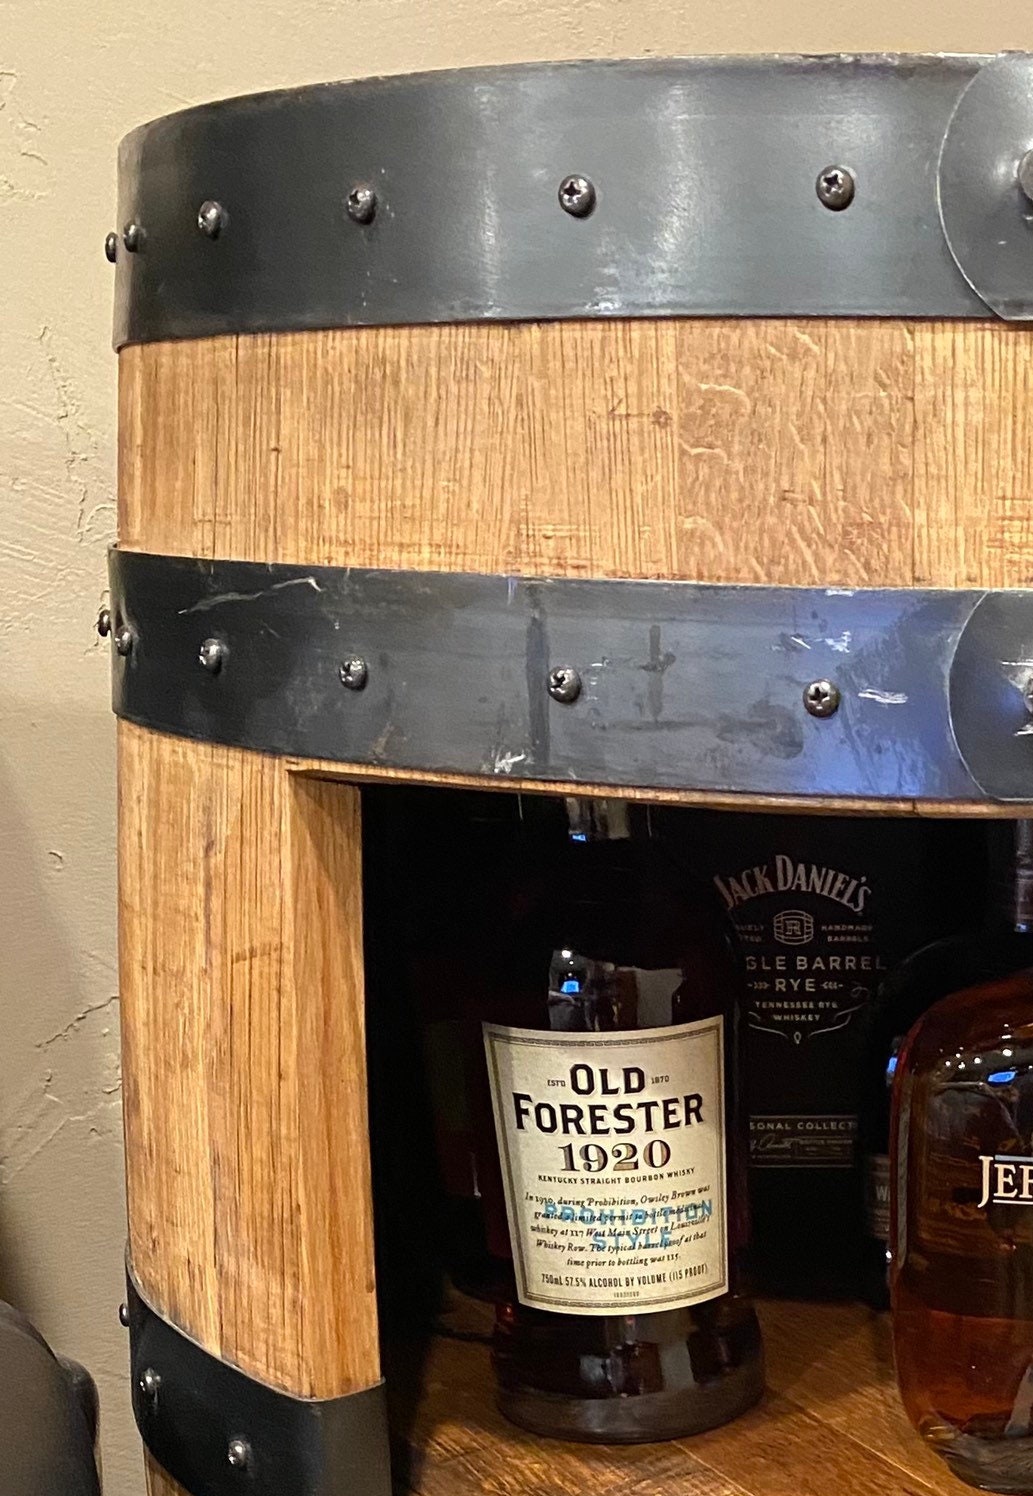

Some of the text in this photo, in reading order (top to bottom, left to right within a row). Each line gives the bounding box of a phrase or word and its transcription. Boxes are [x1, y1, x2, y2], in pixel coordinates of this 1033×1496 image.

[712, 853, 873, 914] JACK DANIEL'S
[744, 955, 888, 971] GLE BARREL
[774, 978, 817, 993] RYE
[754, 1000, 839, 1010] TENNESSEE RYE
[772, 1013, 821, 1022] WHISKEY
[569, 1063, 671, 1096] OLD 1870
[511, 1092, 705, 1136] FORESTER
[557, 1139, 672, 1173] 1920
[538, 1167, 696, 1186] KENTUCKY STRAIGHT BOURBON WHISKY
[557, 1196, 586, 1208] during
[671, 1187, 696, 1200] Brown
[697, 1184, 711, 1195] was
[530, 1223, 560, 1237] whiskey
[632, 1221, 659, 1237] Street
[535, 1239, 567, 1254] Whiskey
[592, 1230, 673, 1250] STYLE
[566, 1255, 666, 1269] time prior to bottling was
[565, 1275, 587, 1288] 57.5%
[588, 1275, 623, 1288] ALCOHOL
[625, 1276, 636, 1287] BY
[636, 1273, 667, 1286] VOLUME
